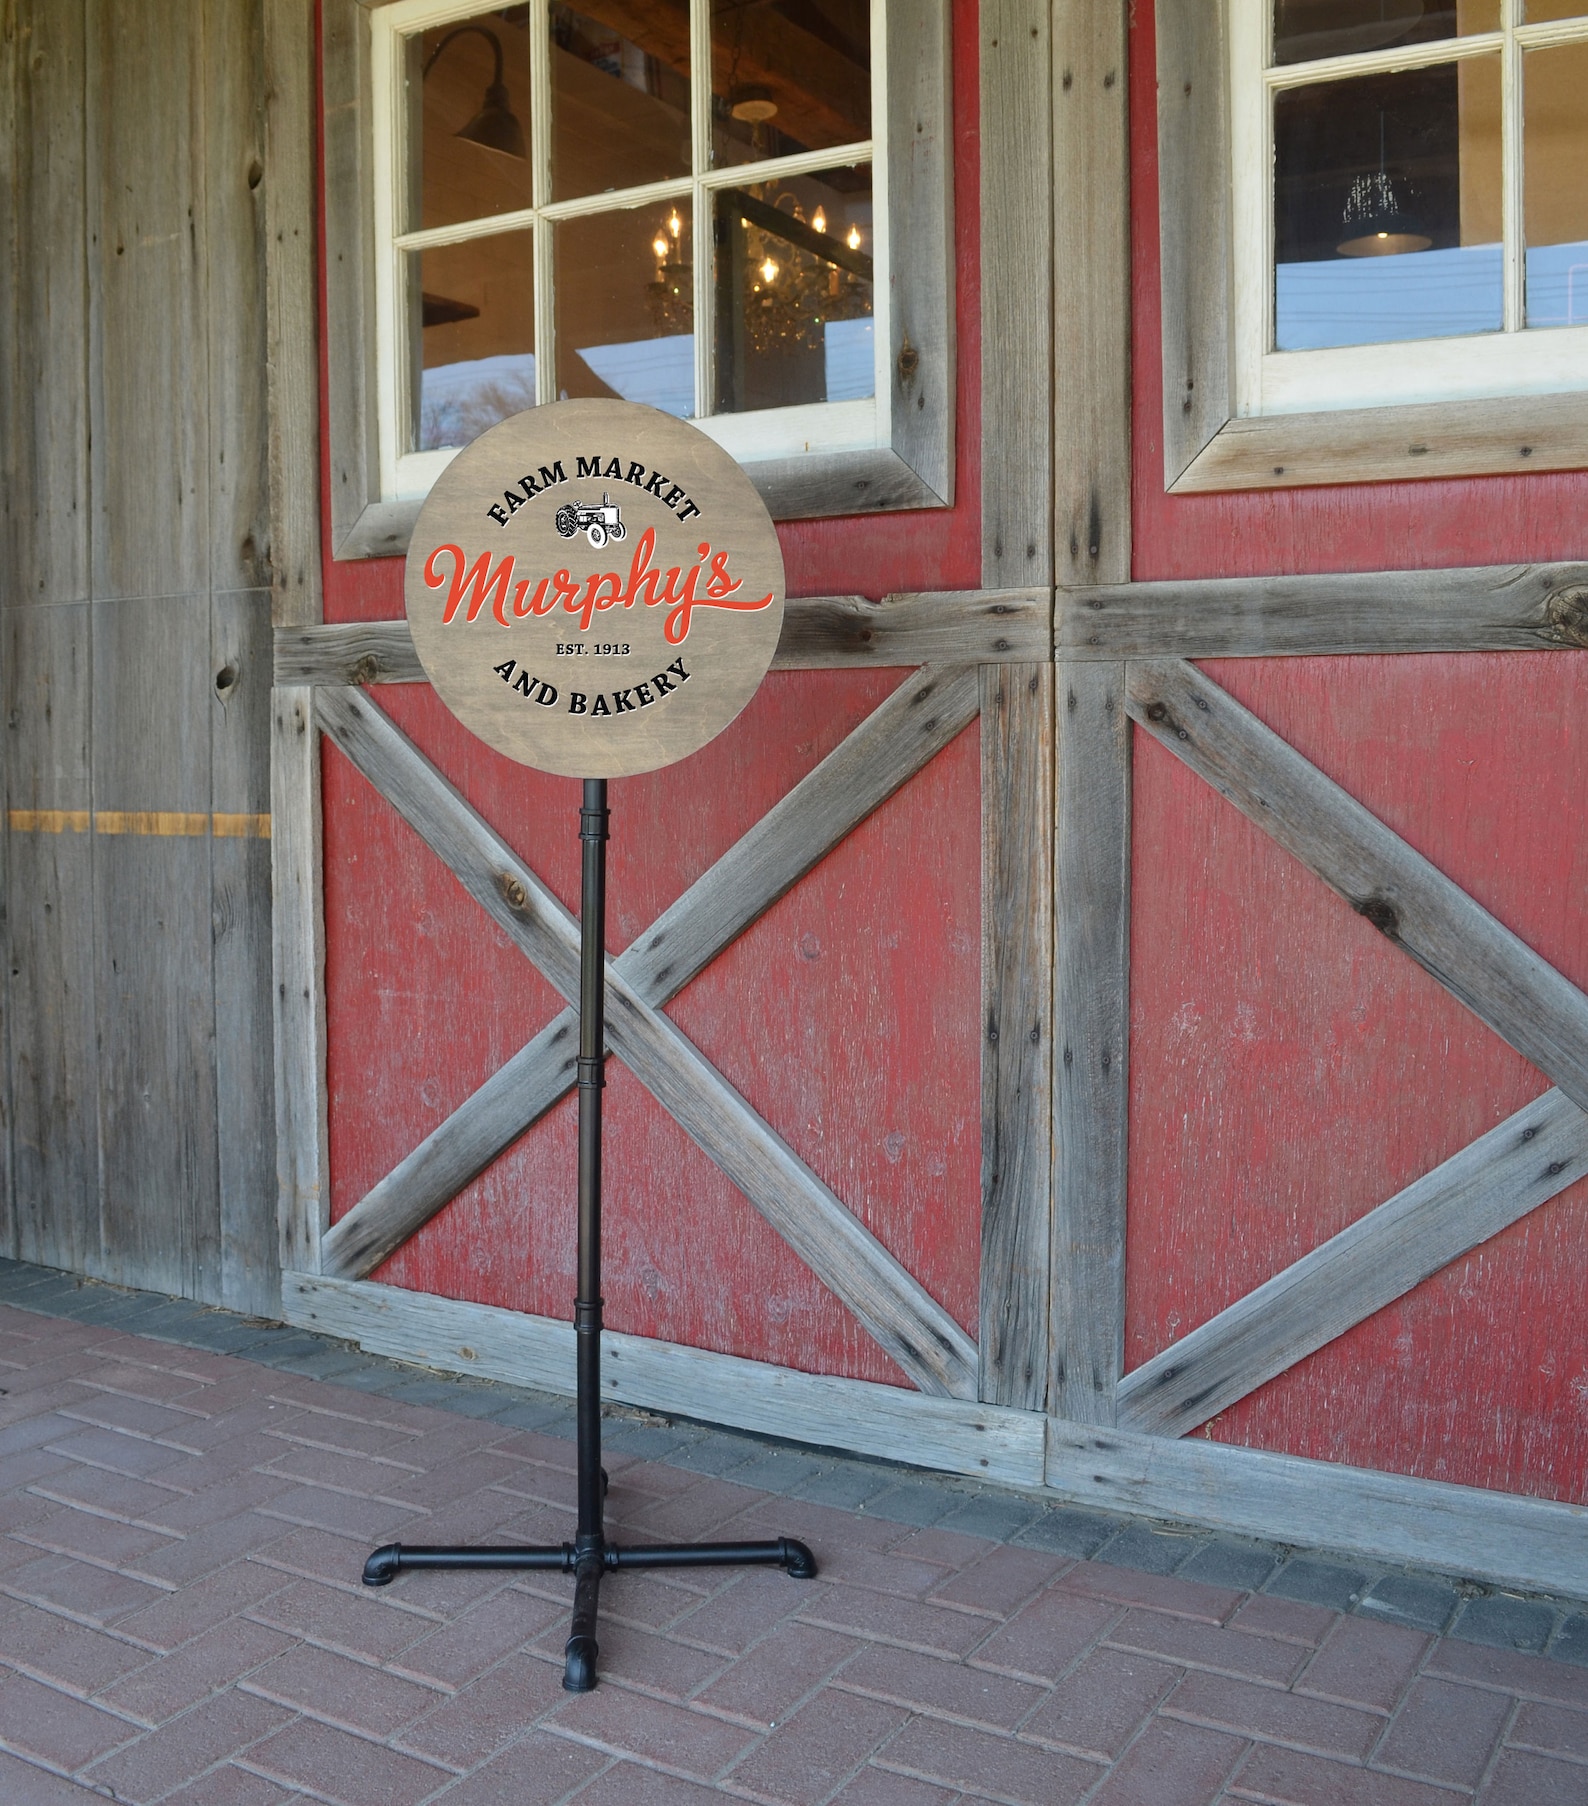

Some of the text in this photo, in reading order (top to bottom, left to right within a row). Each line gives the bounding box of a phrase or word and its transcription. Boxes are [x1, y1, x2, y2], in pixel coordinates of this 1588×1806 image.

[487, 456, 701, 527] FARM MARKET
[423, 526, 774, 645] Murphy's
[556, 643, 631, 657] EST. 1913
[493, 656, 692, 717] AND BAKERY
